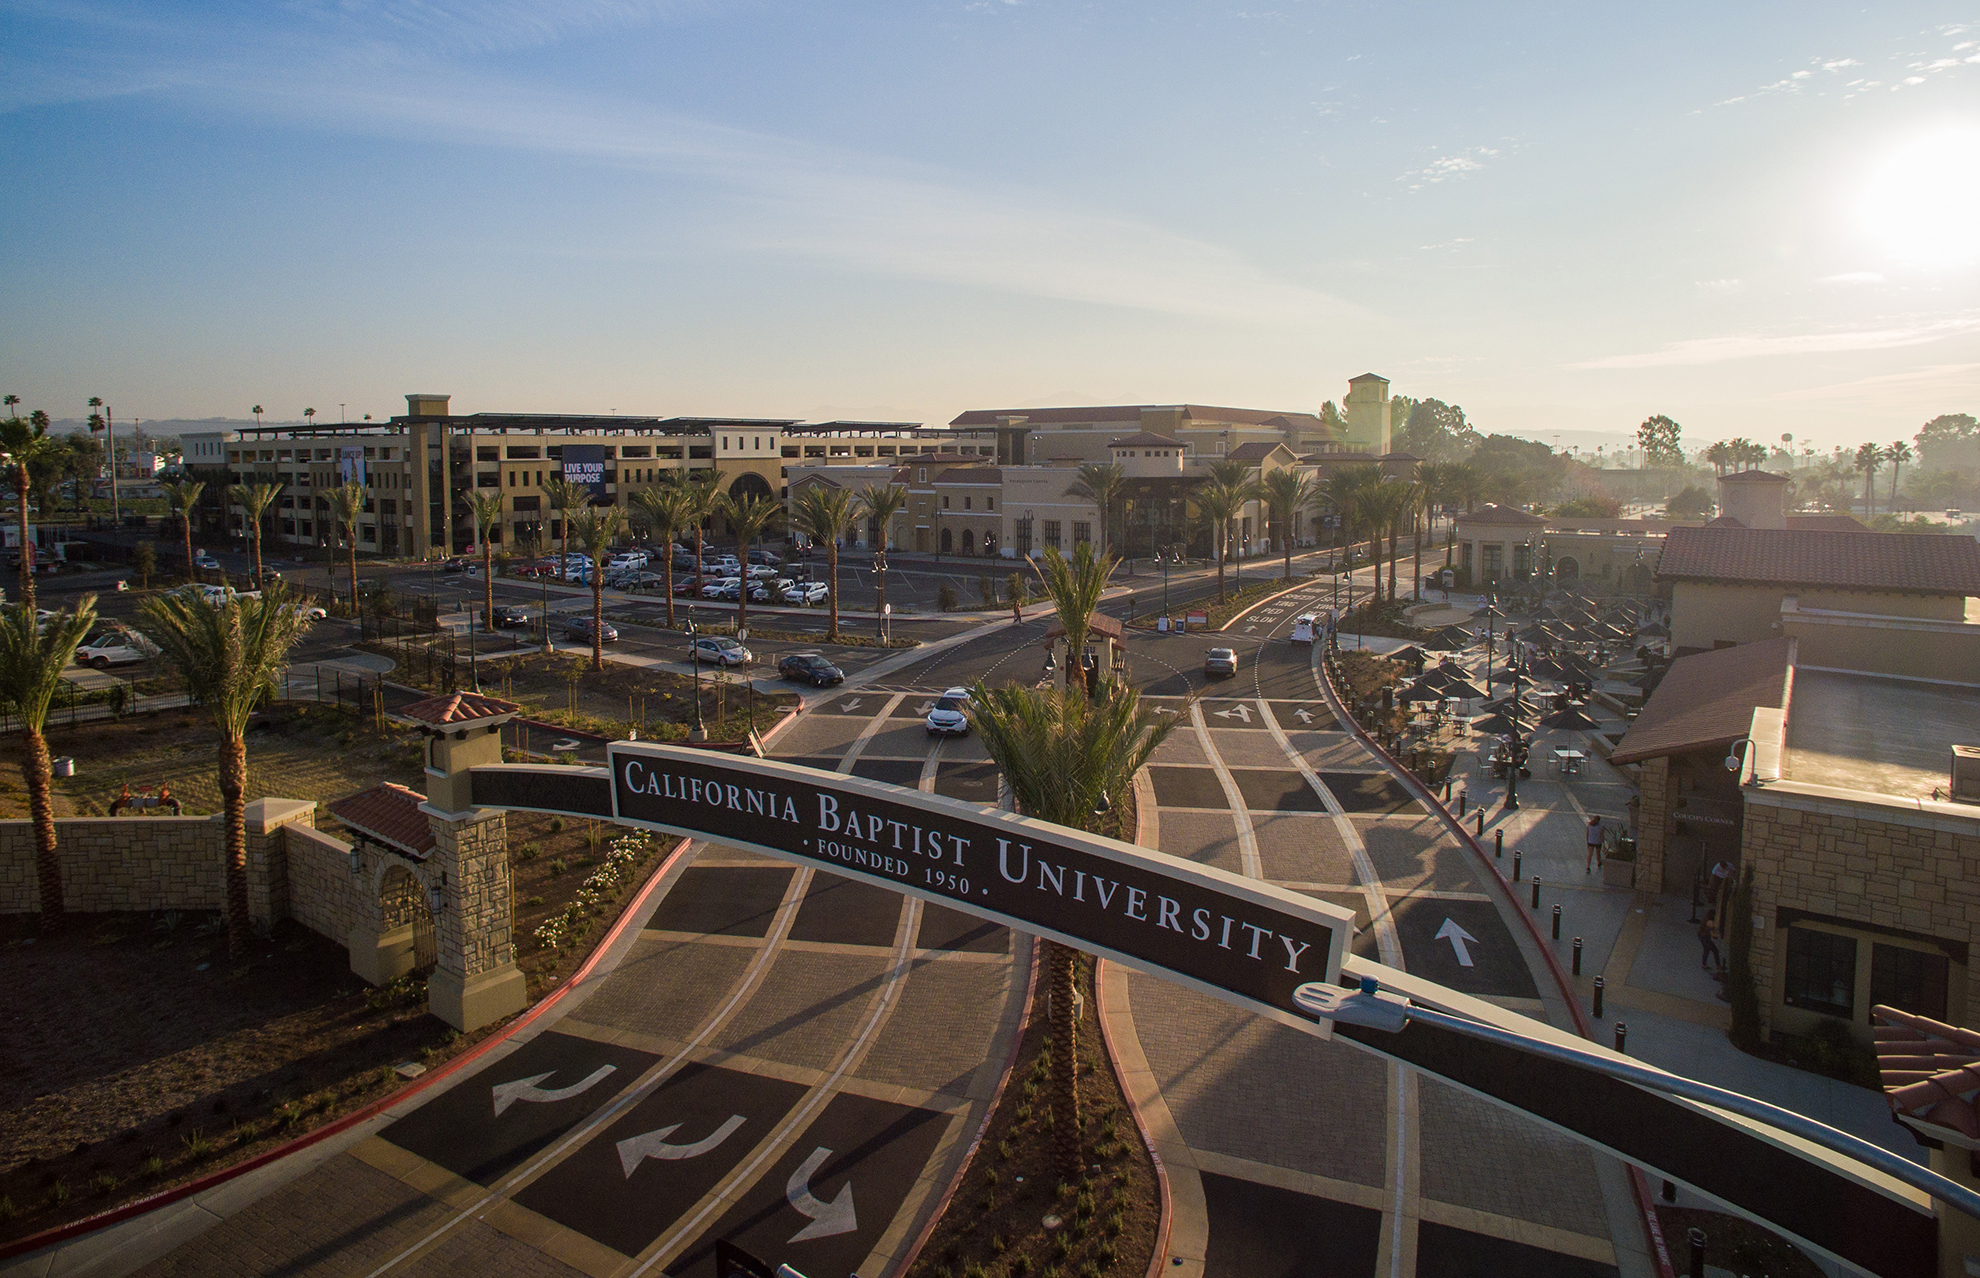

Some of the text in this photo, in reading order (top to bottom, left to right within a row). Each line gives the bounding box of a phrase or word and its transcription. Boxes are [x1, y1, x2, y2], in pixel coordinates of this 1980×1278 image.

[564, 463, 604, 473] LIVE YOUR
[564, 473, 601, 483] PURPOSE
[1272, 600, 1299, 608] XING
[1260, 607, 1284, 615] PED
[625, 761, 1311, 974] CALIFORNIA BAPTIST UNIVERSITY
[817, 838, 970, 895] FOUNDED 1950
[64, 1190, 169, 1229] FIRE LANE NO PARKING
